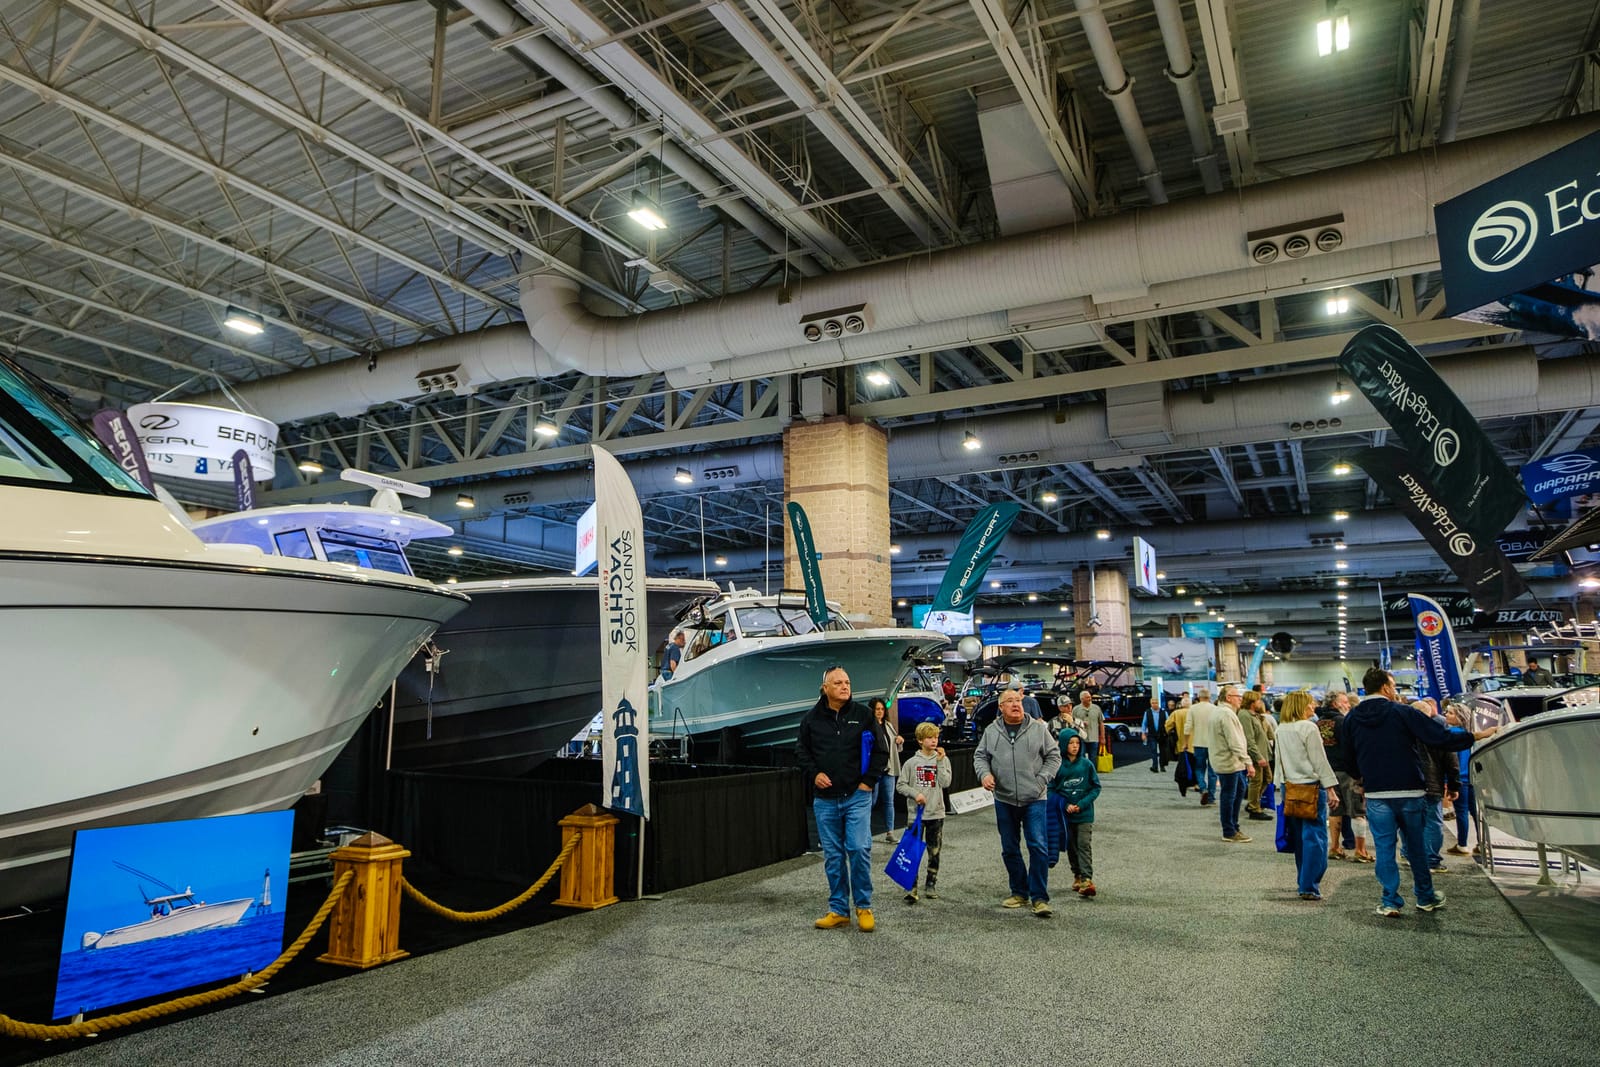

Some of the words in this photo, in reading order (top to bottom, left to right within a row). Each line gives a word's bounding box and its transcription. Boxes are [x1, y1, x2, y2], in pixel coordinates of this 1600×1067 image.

[1378, 360, 1440, 442] EdgeWater
[138, 436, 209, 448] EGAL
[1399, 473, 1458, 537] EdgeWater
[1553, 482, 1591, 494] BOATS
[622, 530, 634, 592] SANDY
[959, 510, 1000, 587] SOUTHPORT
[1500, 541, 1550, 552] OBAL
[610, 538, 623, 645] YACHTS
[625, 598, 637, 653] HOOK
